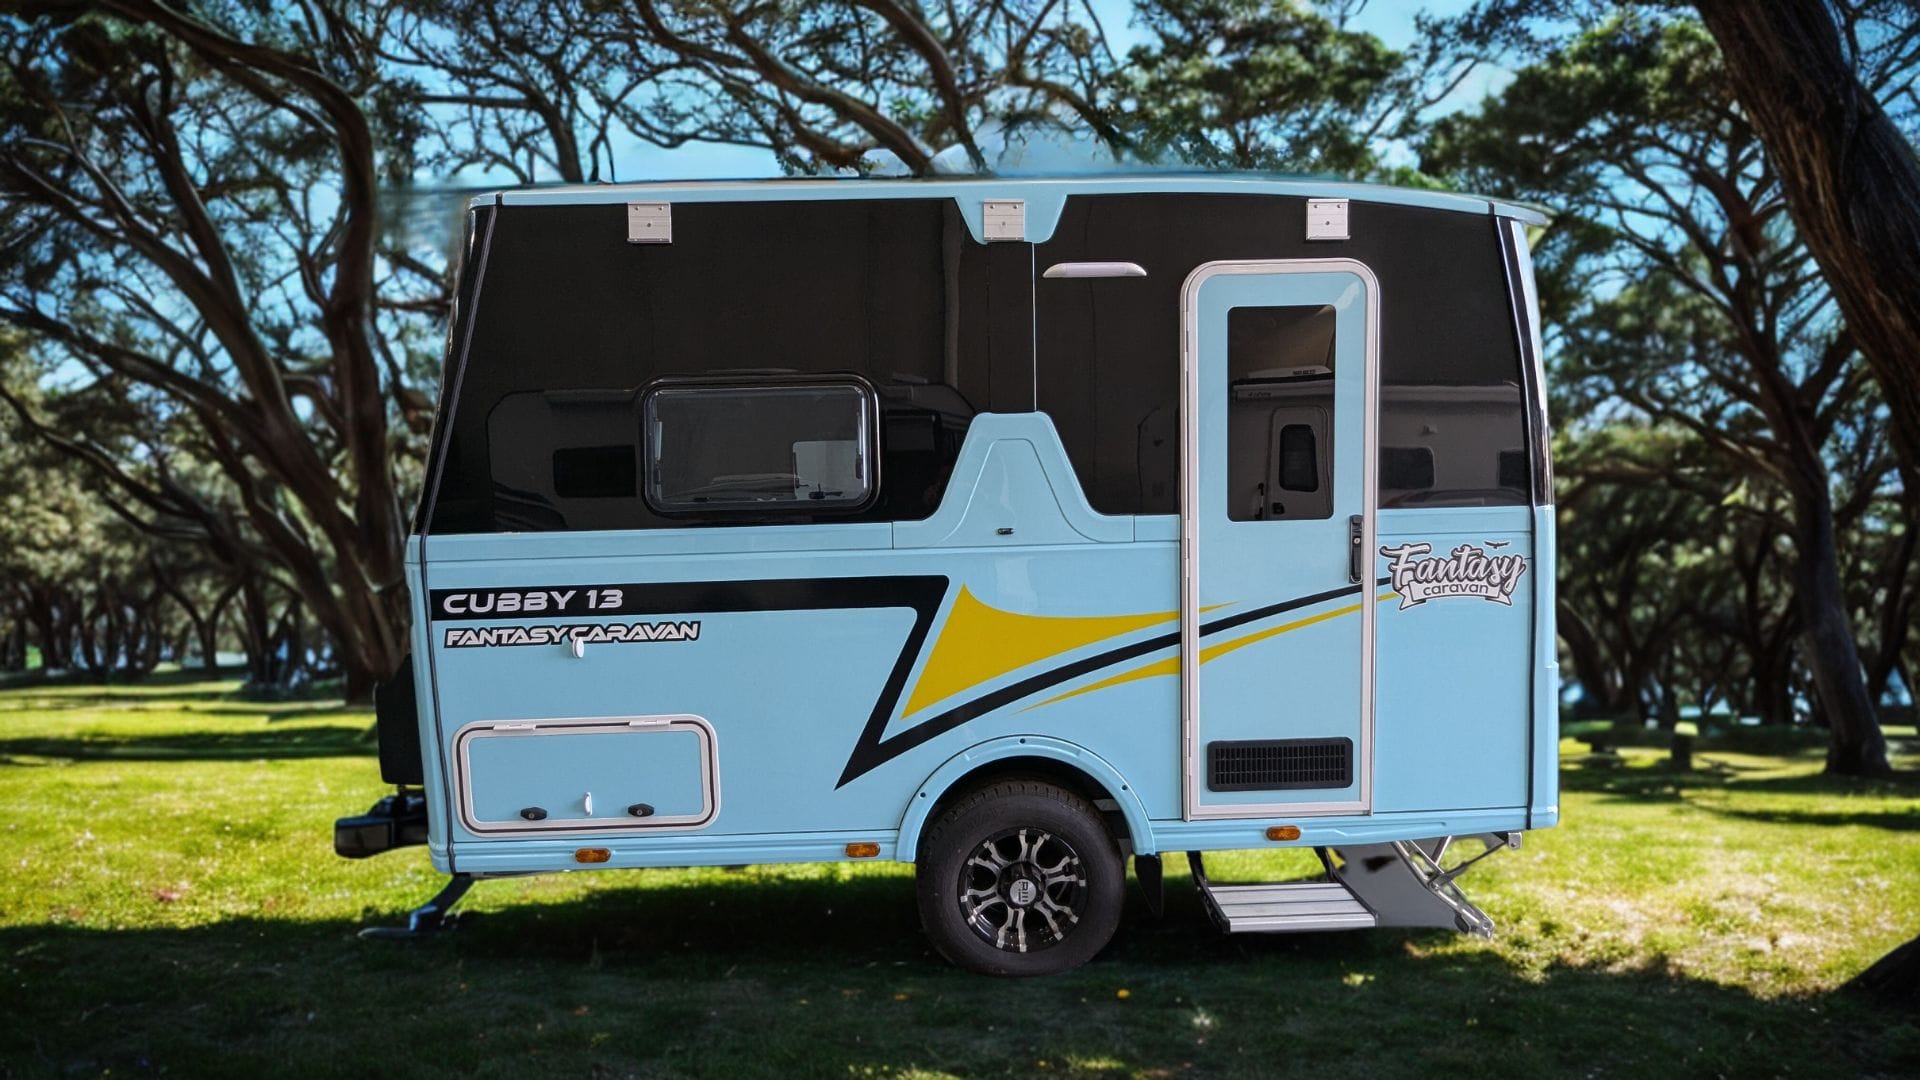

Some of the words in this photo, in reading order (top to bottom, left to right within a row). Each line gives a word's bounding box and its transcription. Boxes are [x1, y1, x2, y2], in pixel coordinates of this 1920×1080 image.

[1379, 543, 1526, 595] Fantasy
[443, 590, 577, 614] CUBBY
[586, 589, 623, 609] 13
[1423, 582, 1489, 596] caravan
